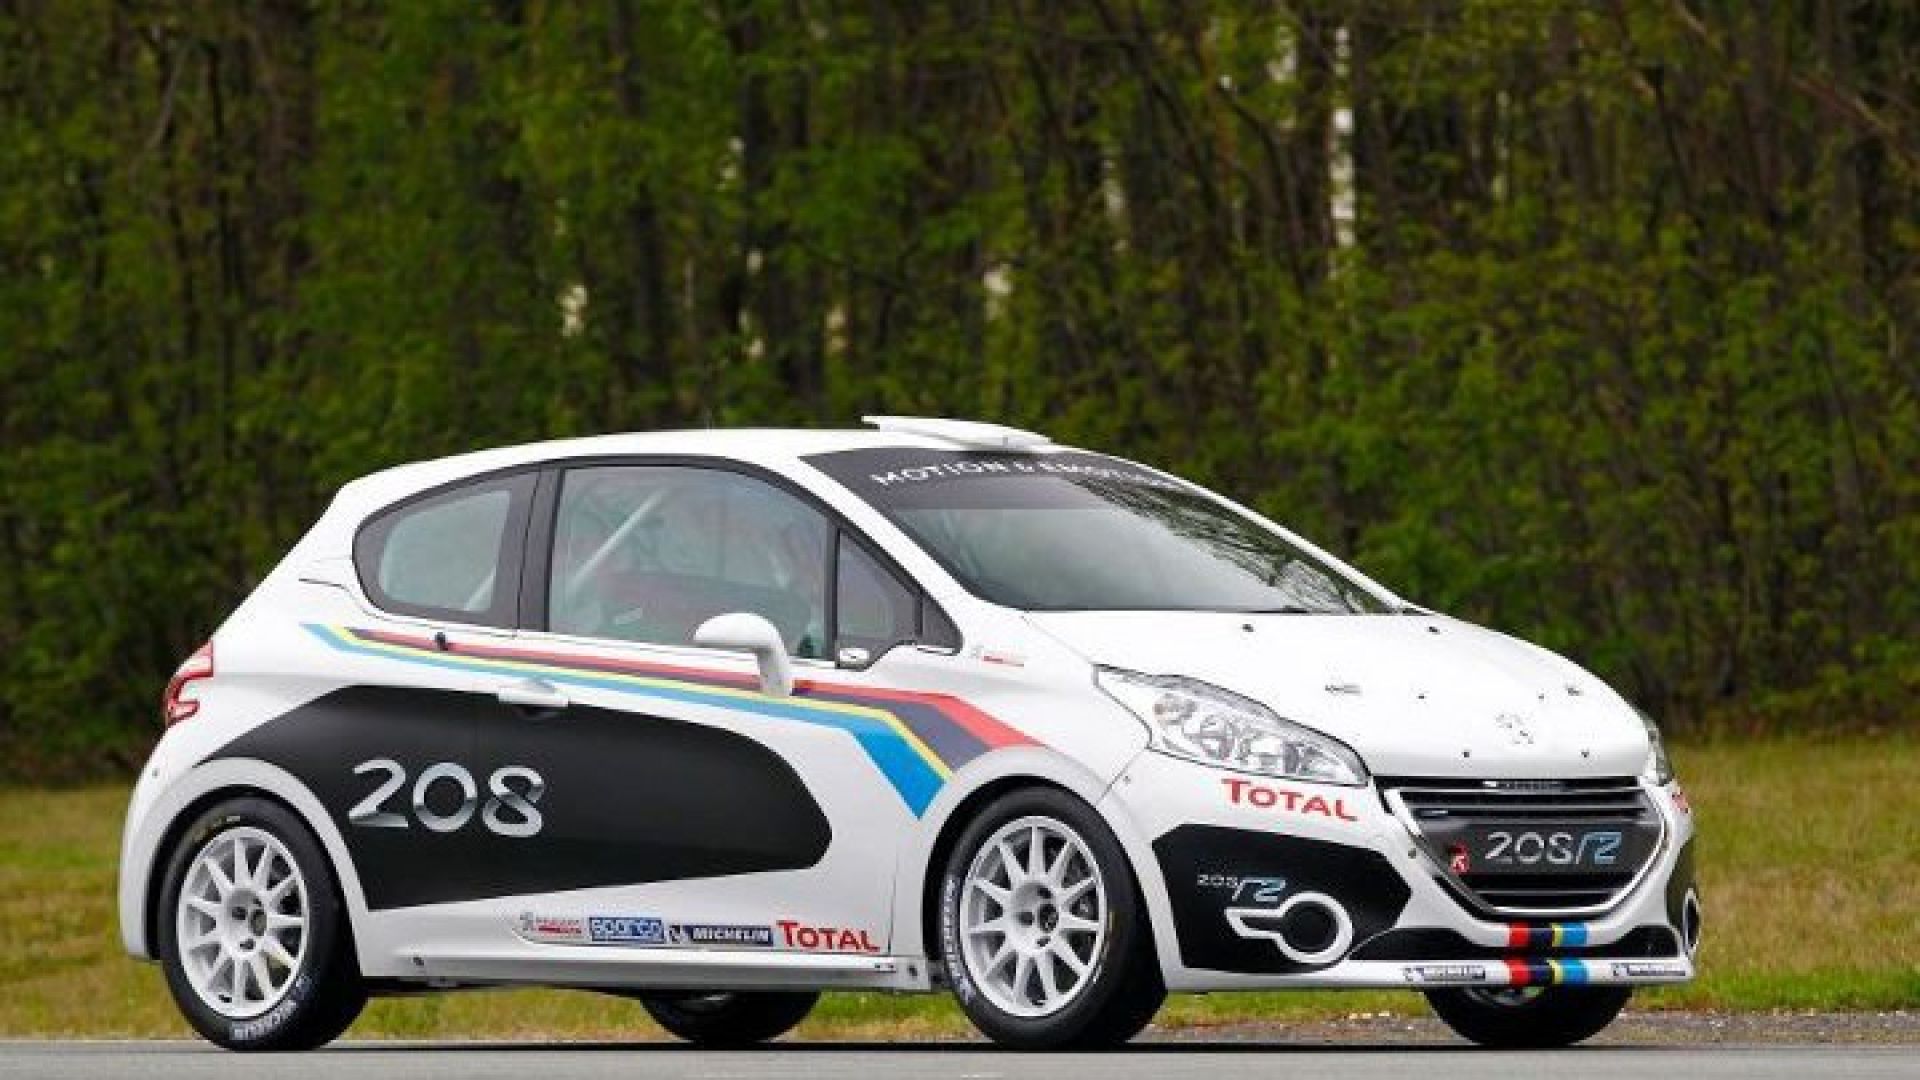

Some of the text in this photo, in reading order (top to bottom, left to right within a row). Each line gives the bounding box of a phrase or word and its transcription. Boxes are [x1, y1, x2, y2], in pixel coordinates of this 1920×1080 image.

[870, 461, 1010, 486] MOTION
[348, 759, 545, 838] 208
[1221, 778, 1358, 822] TOTAL
[1485, 832, 1573, 864] 208
[692, 926, 770, 943] MICHELIN
[776, 920, 880, 952] TOTAL
